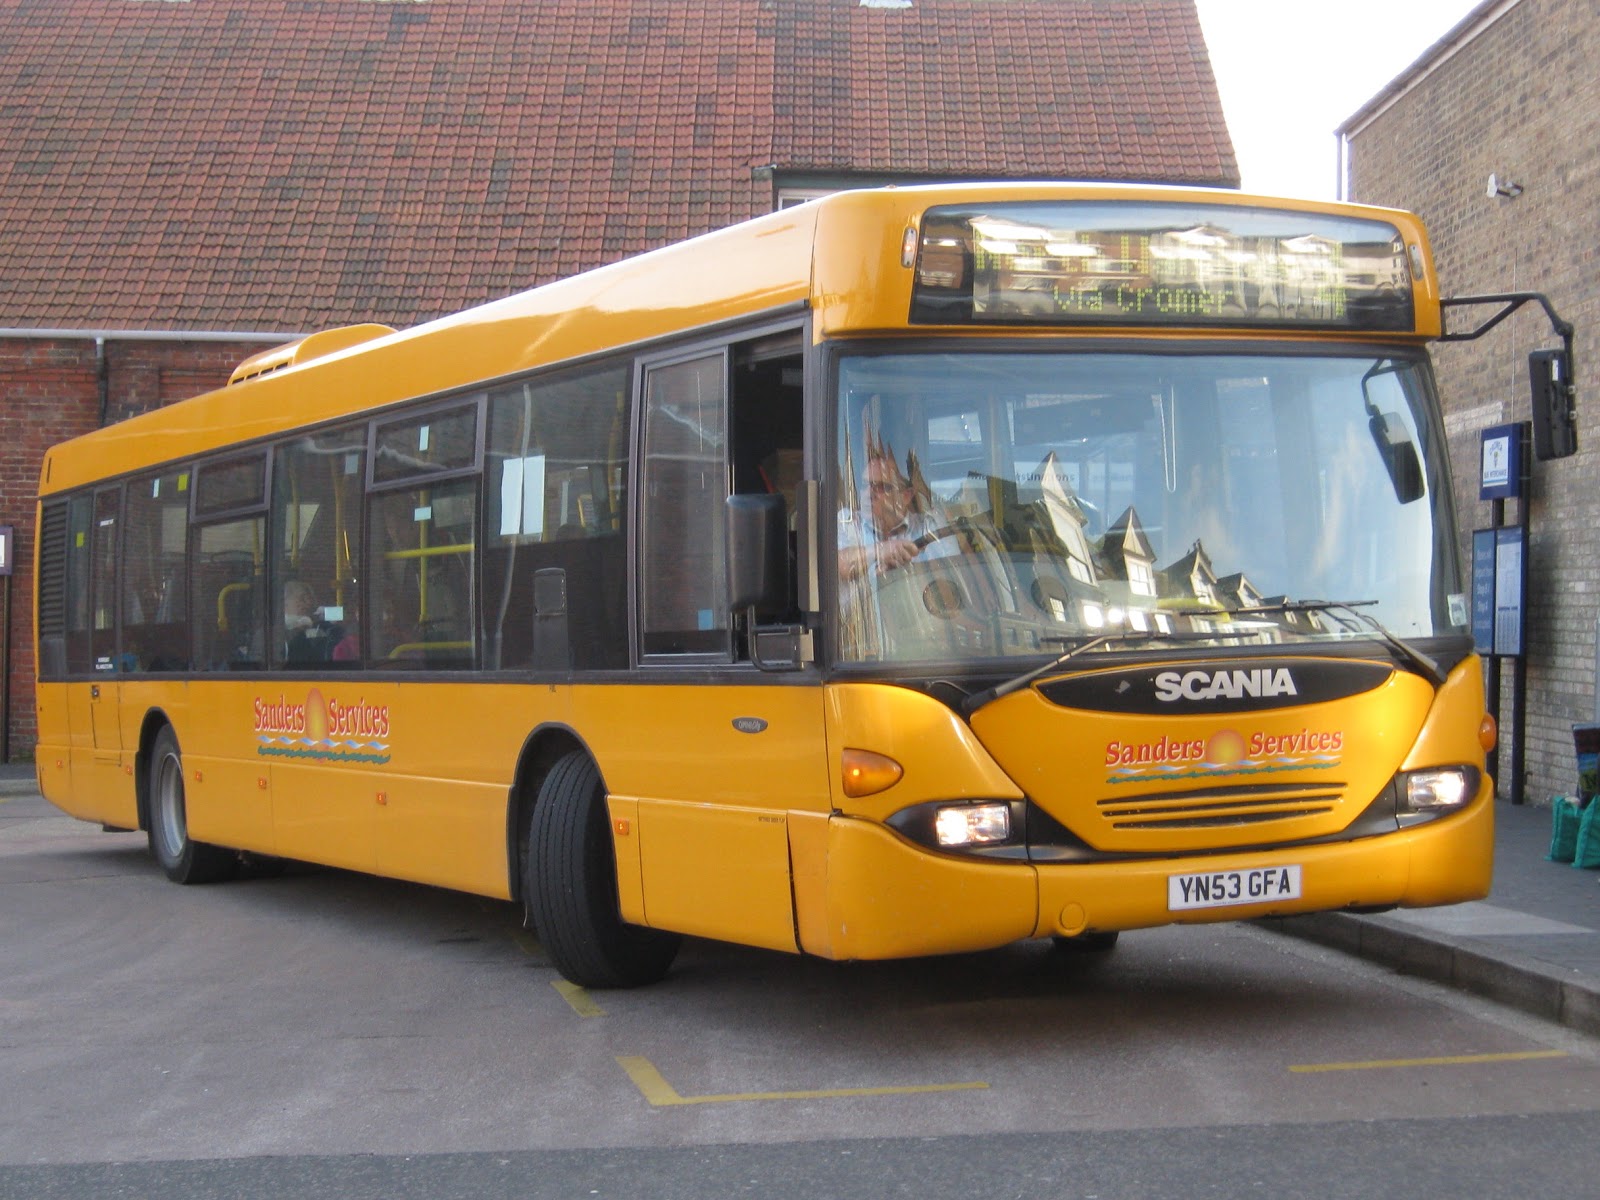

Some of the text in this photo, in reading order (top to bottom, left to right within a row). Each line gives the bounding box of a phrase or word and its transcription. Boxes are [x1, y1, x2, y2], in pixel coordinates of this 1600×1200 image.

[1053, 282, 1234, 315] via Cromer
[1154, 668, 1298, 702] SCANIA
[254, 694, 390, 738] Sanders Services
[1105, 728, 1344, 767] Sanders Services
[1179, 868, 1291, 903] YN53 GFA
